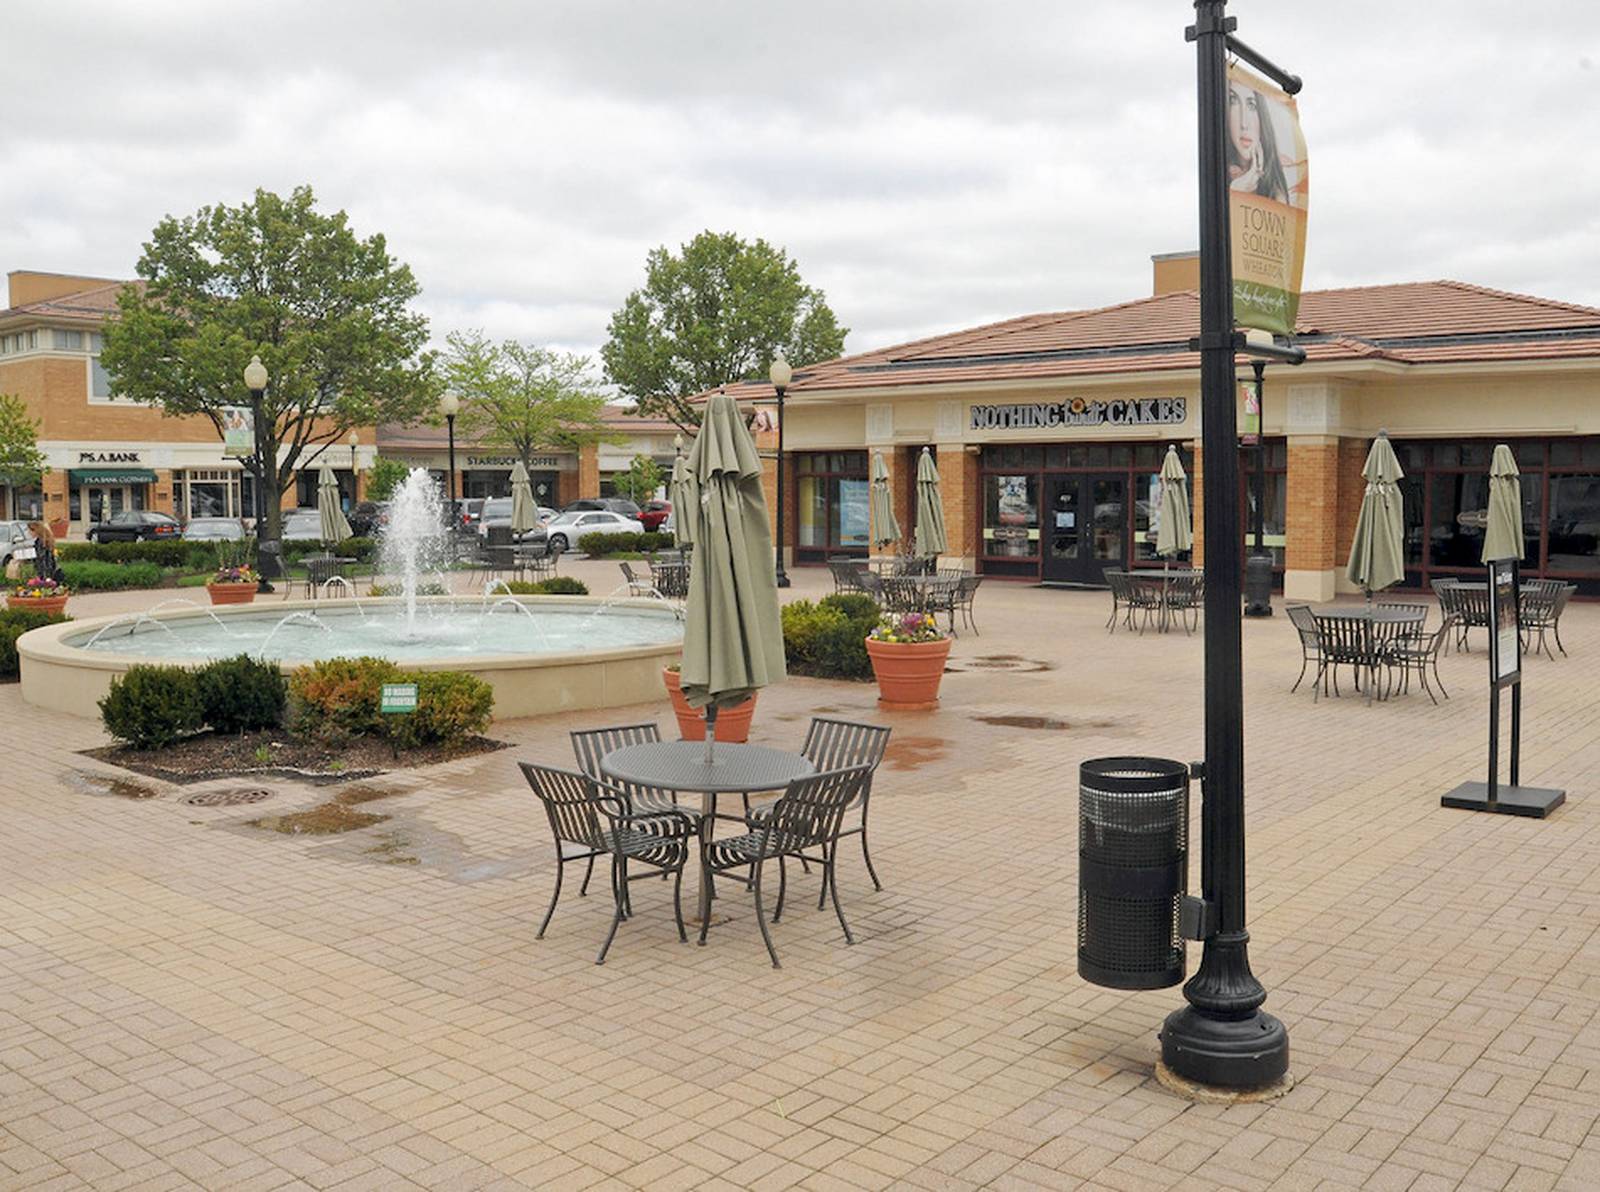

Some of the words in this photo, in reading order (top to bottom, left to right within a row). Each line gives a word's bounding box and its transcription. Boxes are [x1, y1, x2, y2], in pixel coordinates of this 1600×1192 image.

[1240, 205, 1286, 237] TOWN
[970, 404, 1059, 429] NOTHING
[1107, 398, 1186, 425] CAKES
[108, 452, 141, 463] BANK
